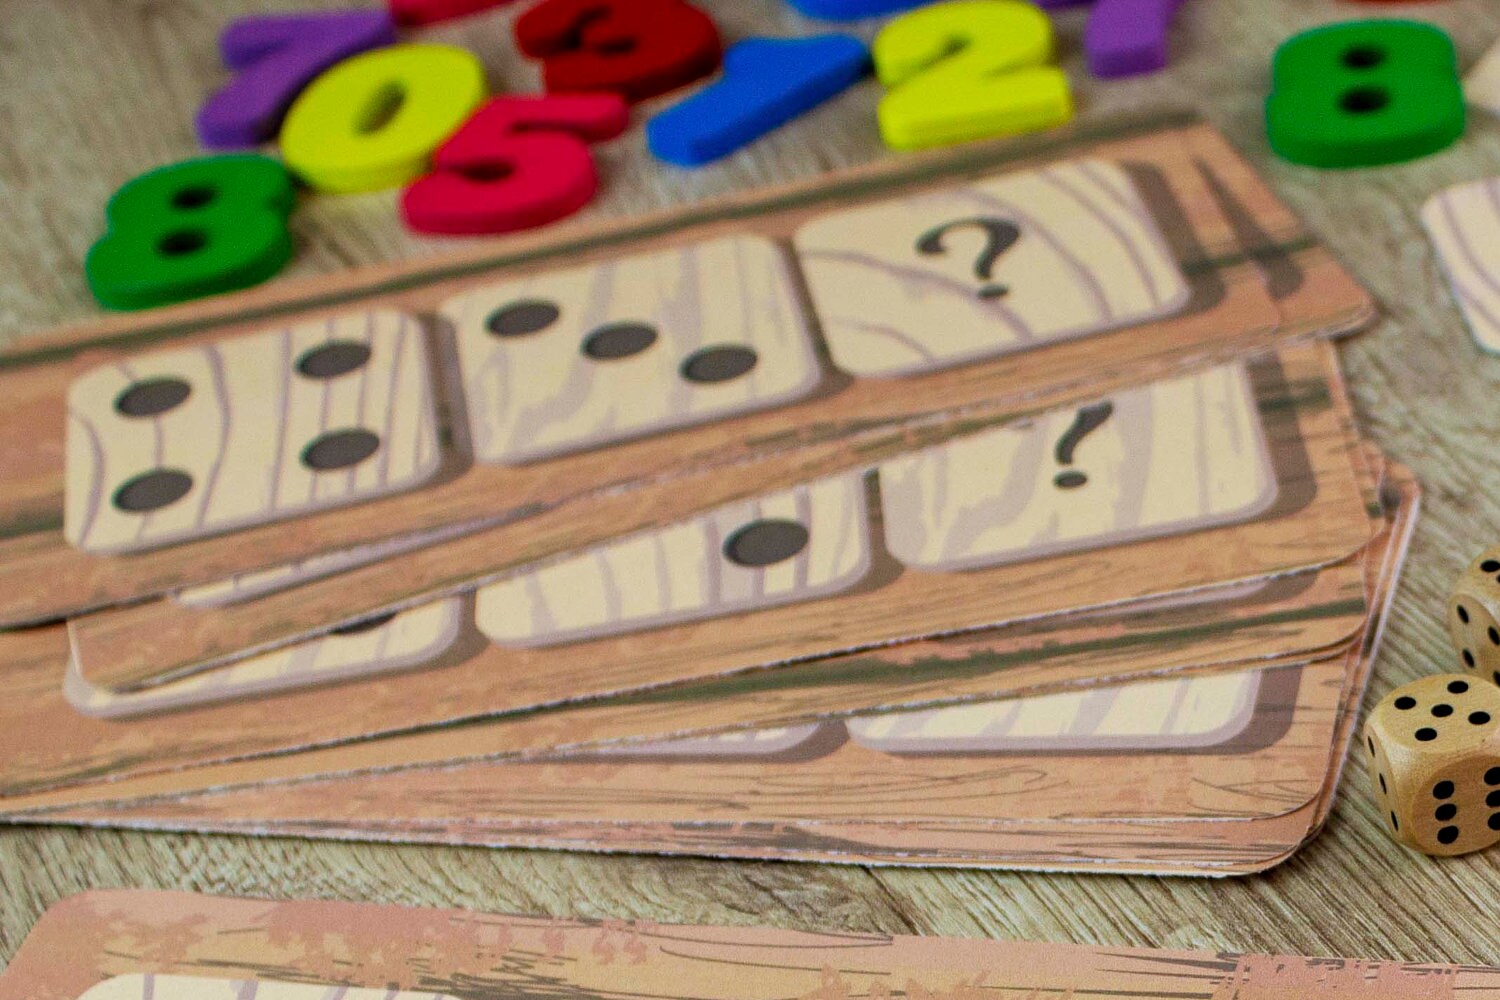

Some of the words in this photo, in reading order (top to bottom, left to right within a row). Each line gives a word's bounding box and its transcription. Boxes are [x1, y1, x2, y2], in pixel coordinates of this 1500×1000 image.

[866, 0, 1074, 151] 2
[1265, 17, 1466, 170] 8
[86, 152, 297, 312] 8
[401, 91, 629, 238] 5
[915, 216, 1020, 301] ?
